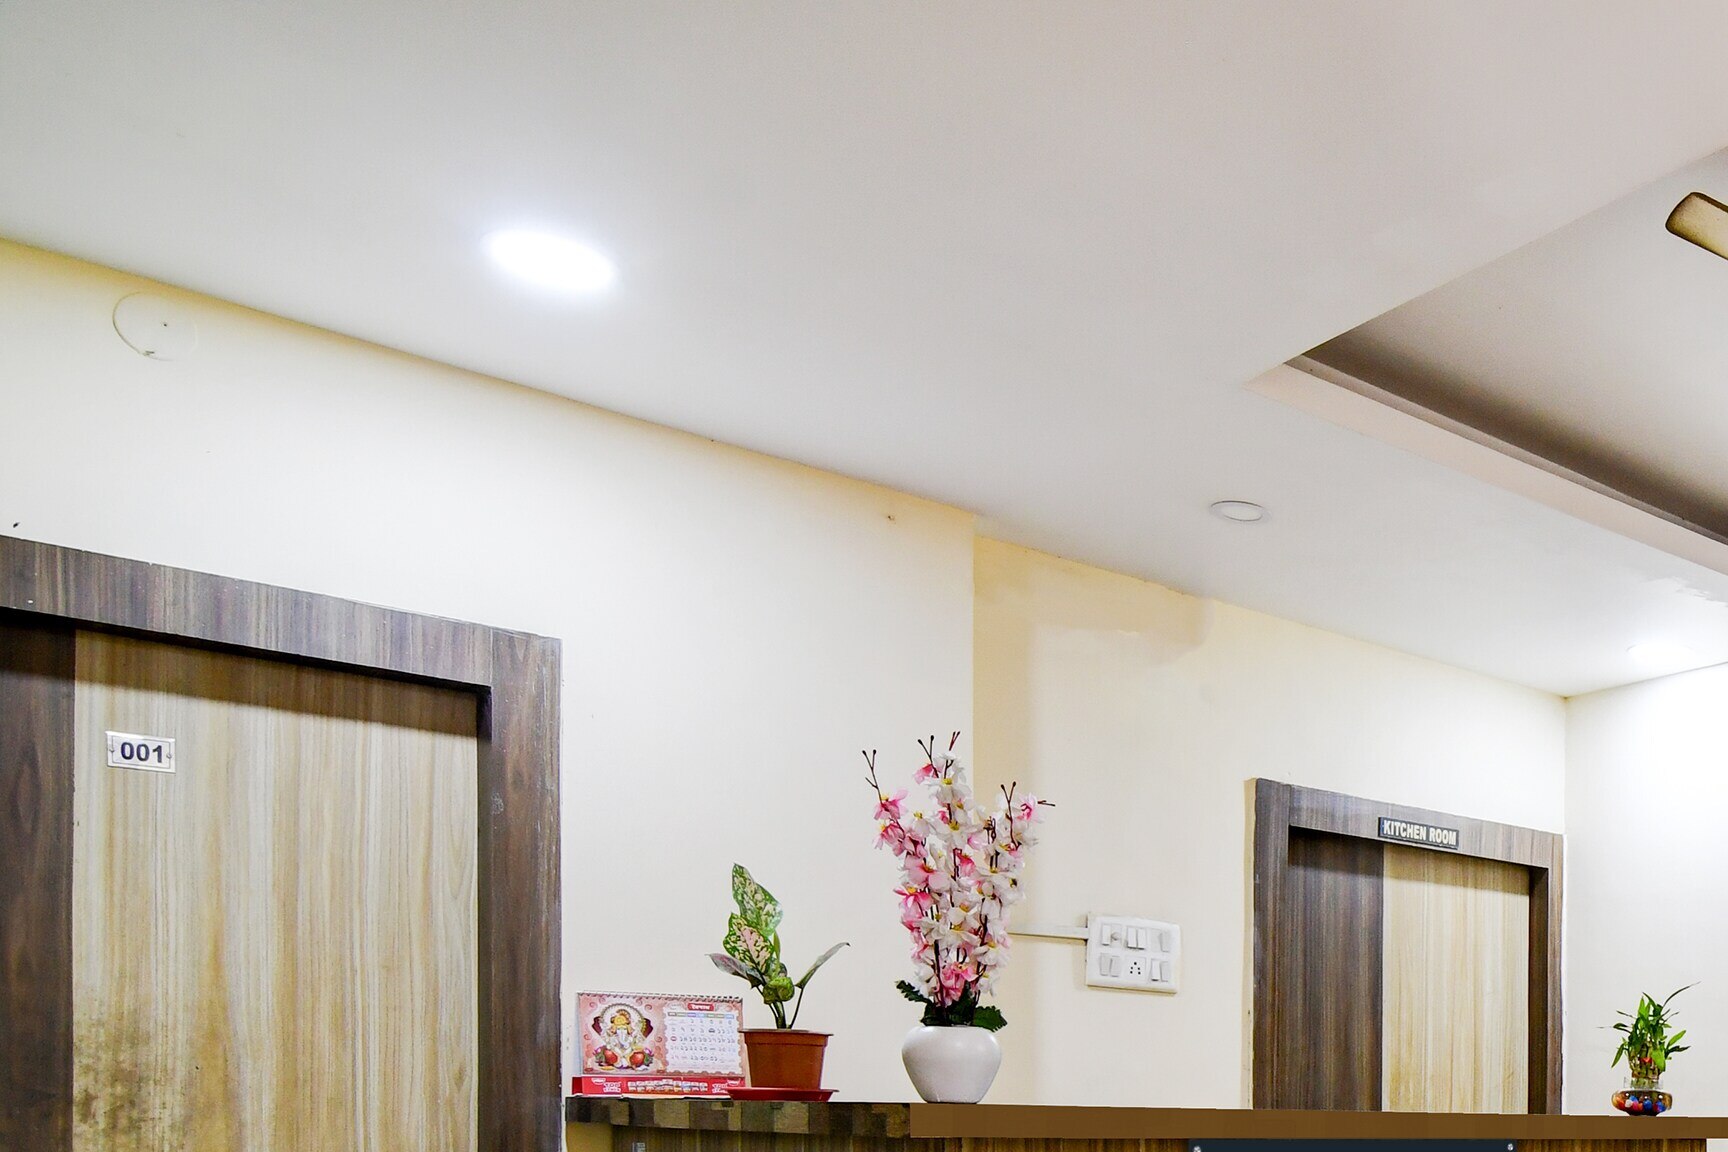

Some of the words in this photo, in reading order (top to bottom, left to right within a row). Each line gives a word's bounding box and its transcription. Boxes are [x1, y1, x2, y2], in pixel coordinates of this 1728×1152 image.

[120, 741, 162, 764] 001
[1383, 819, 1426, 841] KITCHEN
[1429, 827, 1457, 846] ROOM
